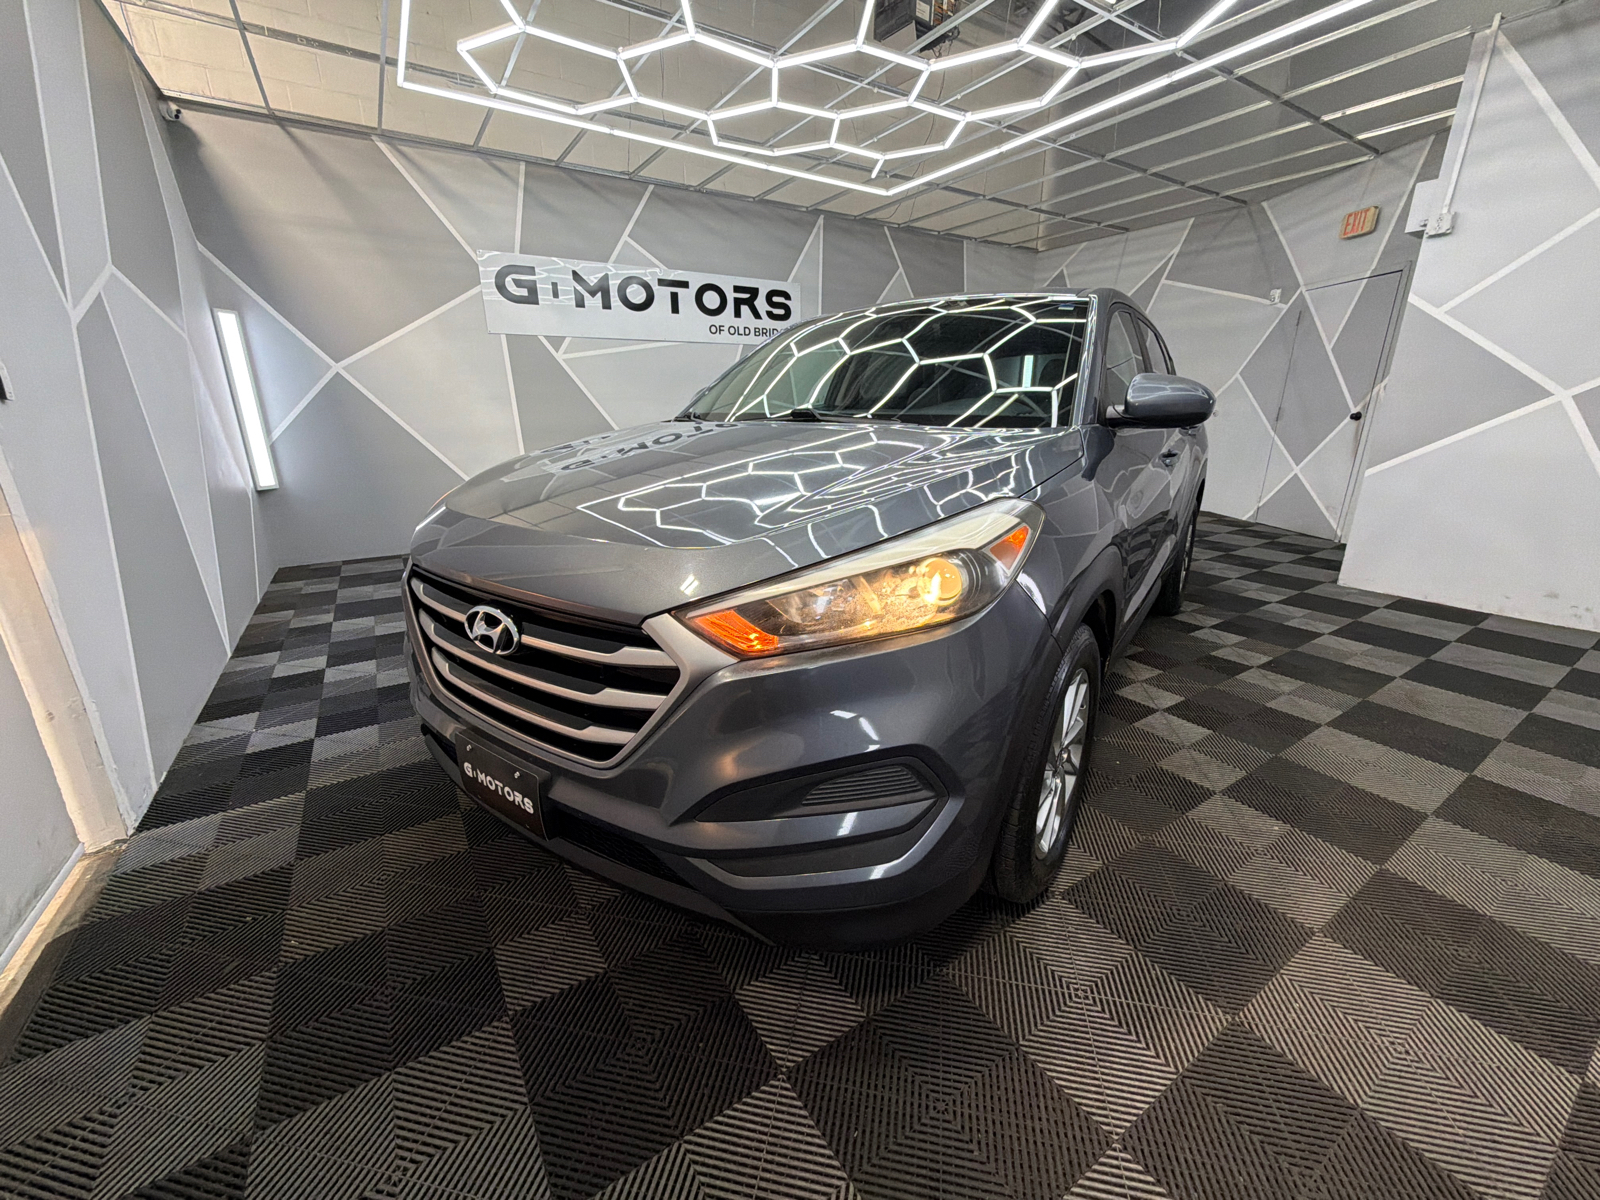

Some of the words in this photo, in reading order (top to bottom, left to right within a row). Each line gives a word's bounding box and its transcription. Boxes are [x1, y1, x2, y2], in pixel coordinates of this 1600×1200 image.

[1343, 207, 1371, 237] EXIT
[708, 324, 725, 335] OF
[727, 325, 751, 336] OLD
[753, 326, 781, 338] BRID
